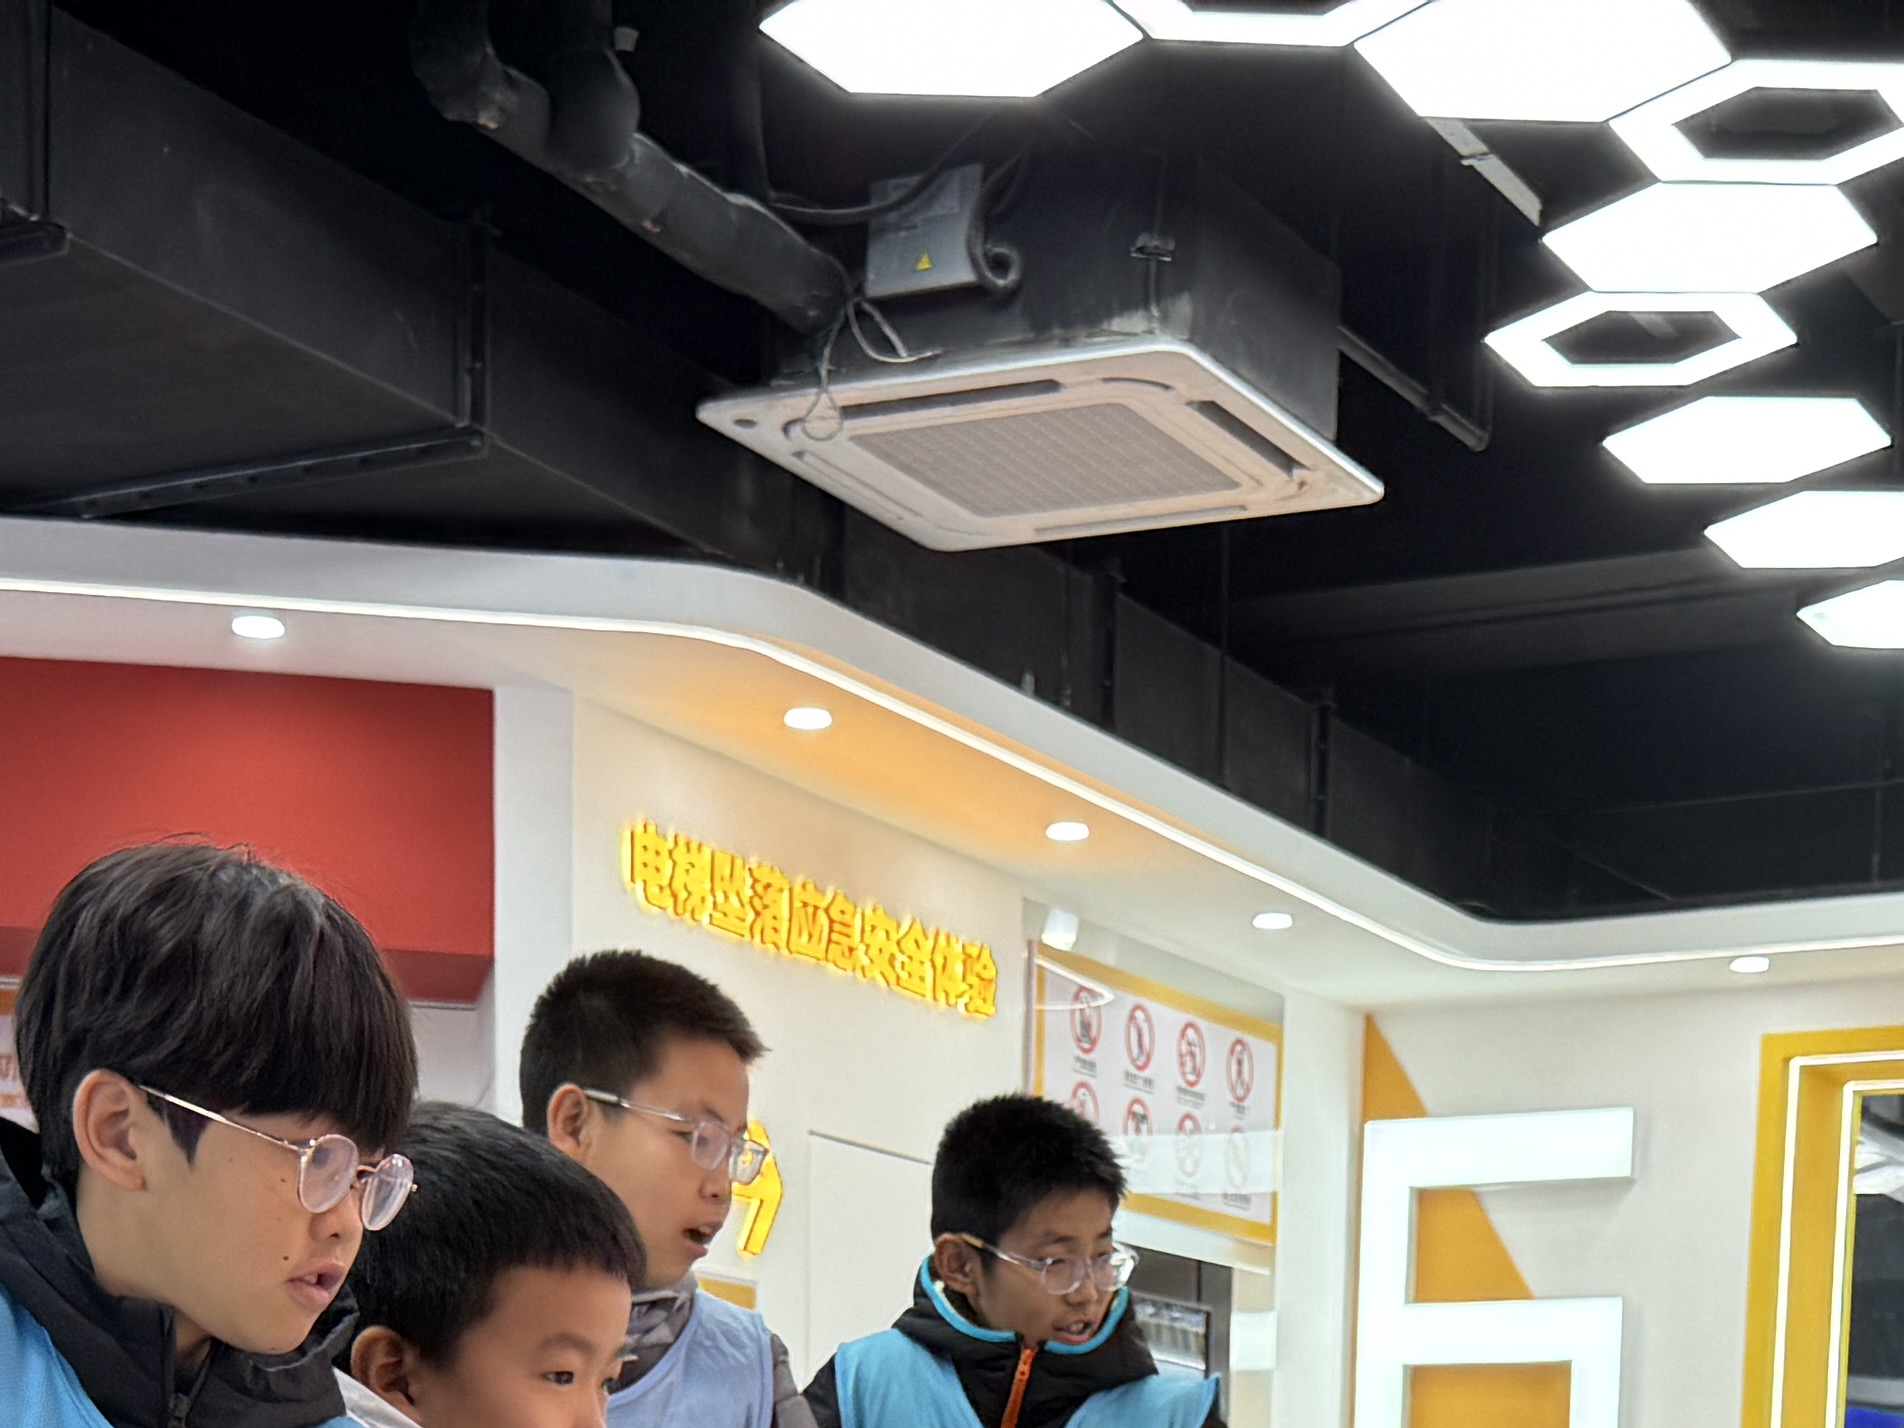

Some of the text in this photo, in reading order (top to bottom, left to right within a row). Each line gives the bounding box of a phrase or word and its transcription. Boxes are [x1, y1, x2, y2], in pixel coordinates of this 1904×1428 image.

[623, 819, 997, 1019] 电梯坠落应急安全体验
